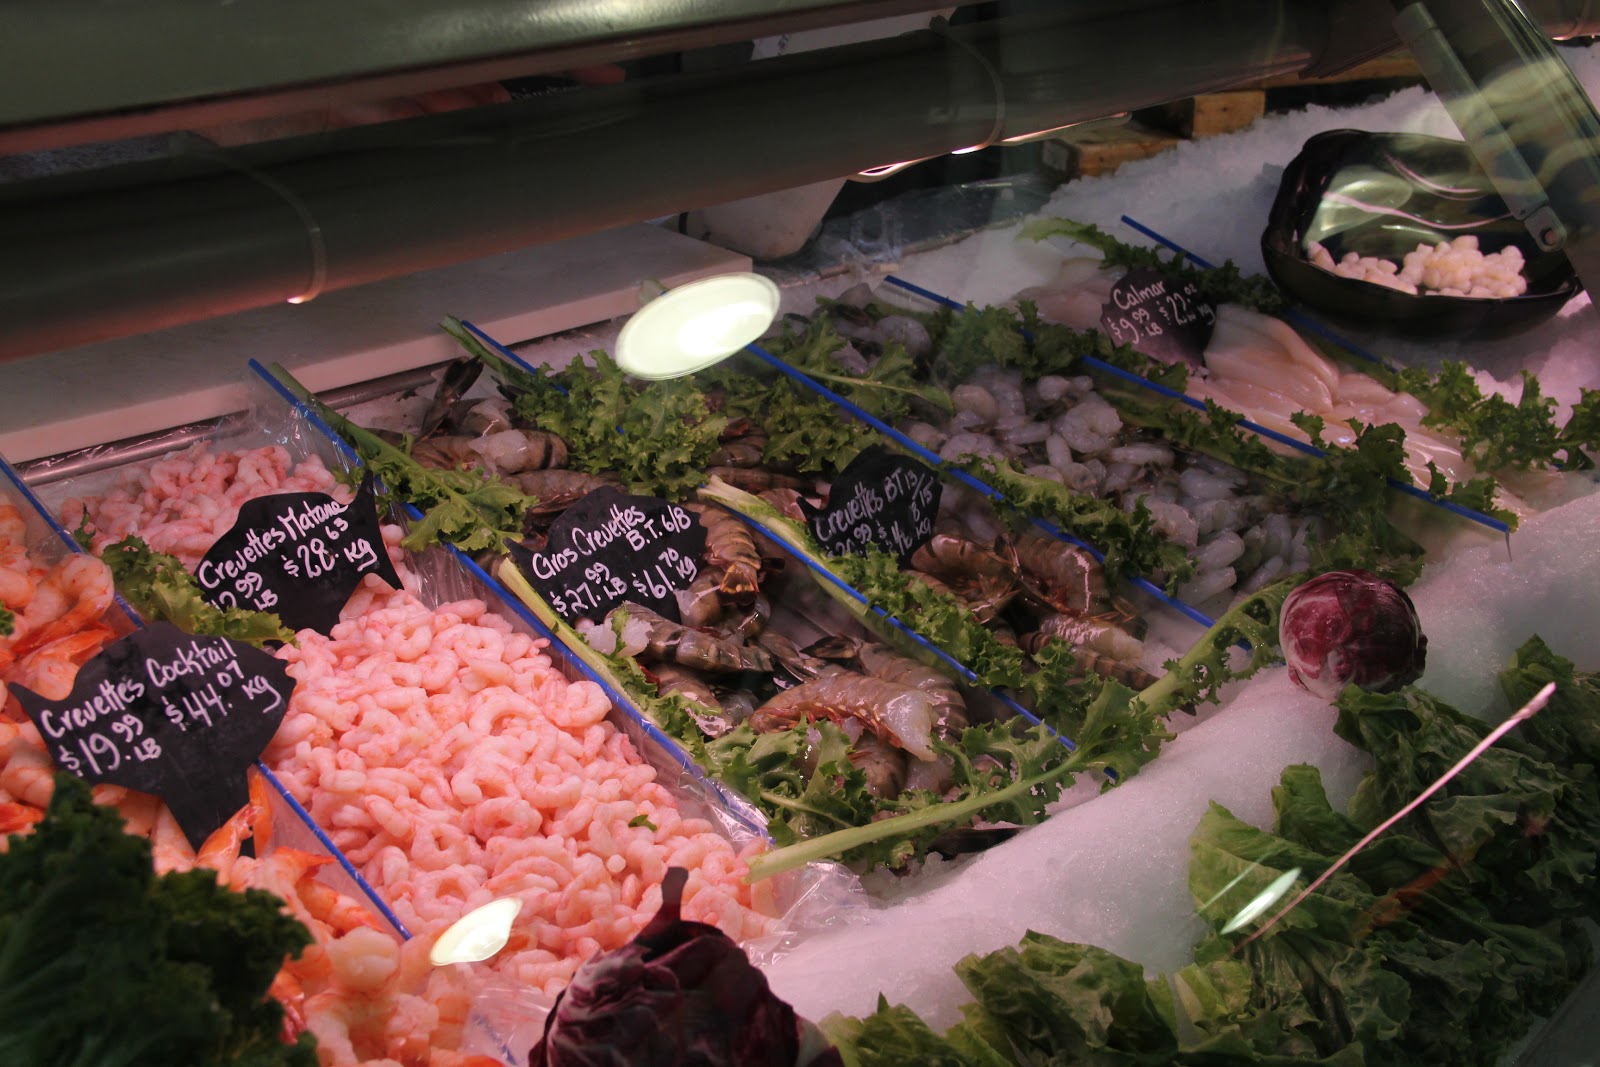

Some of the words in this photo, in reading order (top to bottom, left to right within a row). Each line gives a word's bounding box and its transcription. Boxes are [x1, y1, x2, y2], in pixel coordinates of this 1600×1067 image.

[1113, 281, 1166, 310] Calmar
[532, 547, 579, 580] Gros
[572, 503, 646, 556] Crevettes
[661, 504, 692, 534] 6/8
[815, 481, 884, 542] Crevettes
[884, 467, 904, 503] BT
[199, 528, 286, 589] Crevettes
[277, 500, 349, 541] Matane
[40, 679, 145, 738] Crevettes
[146, 636, 237, 688] Cocktail
